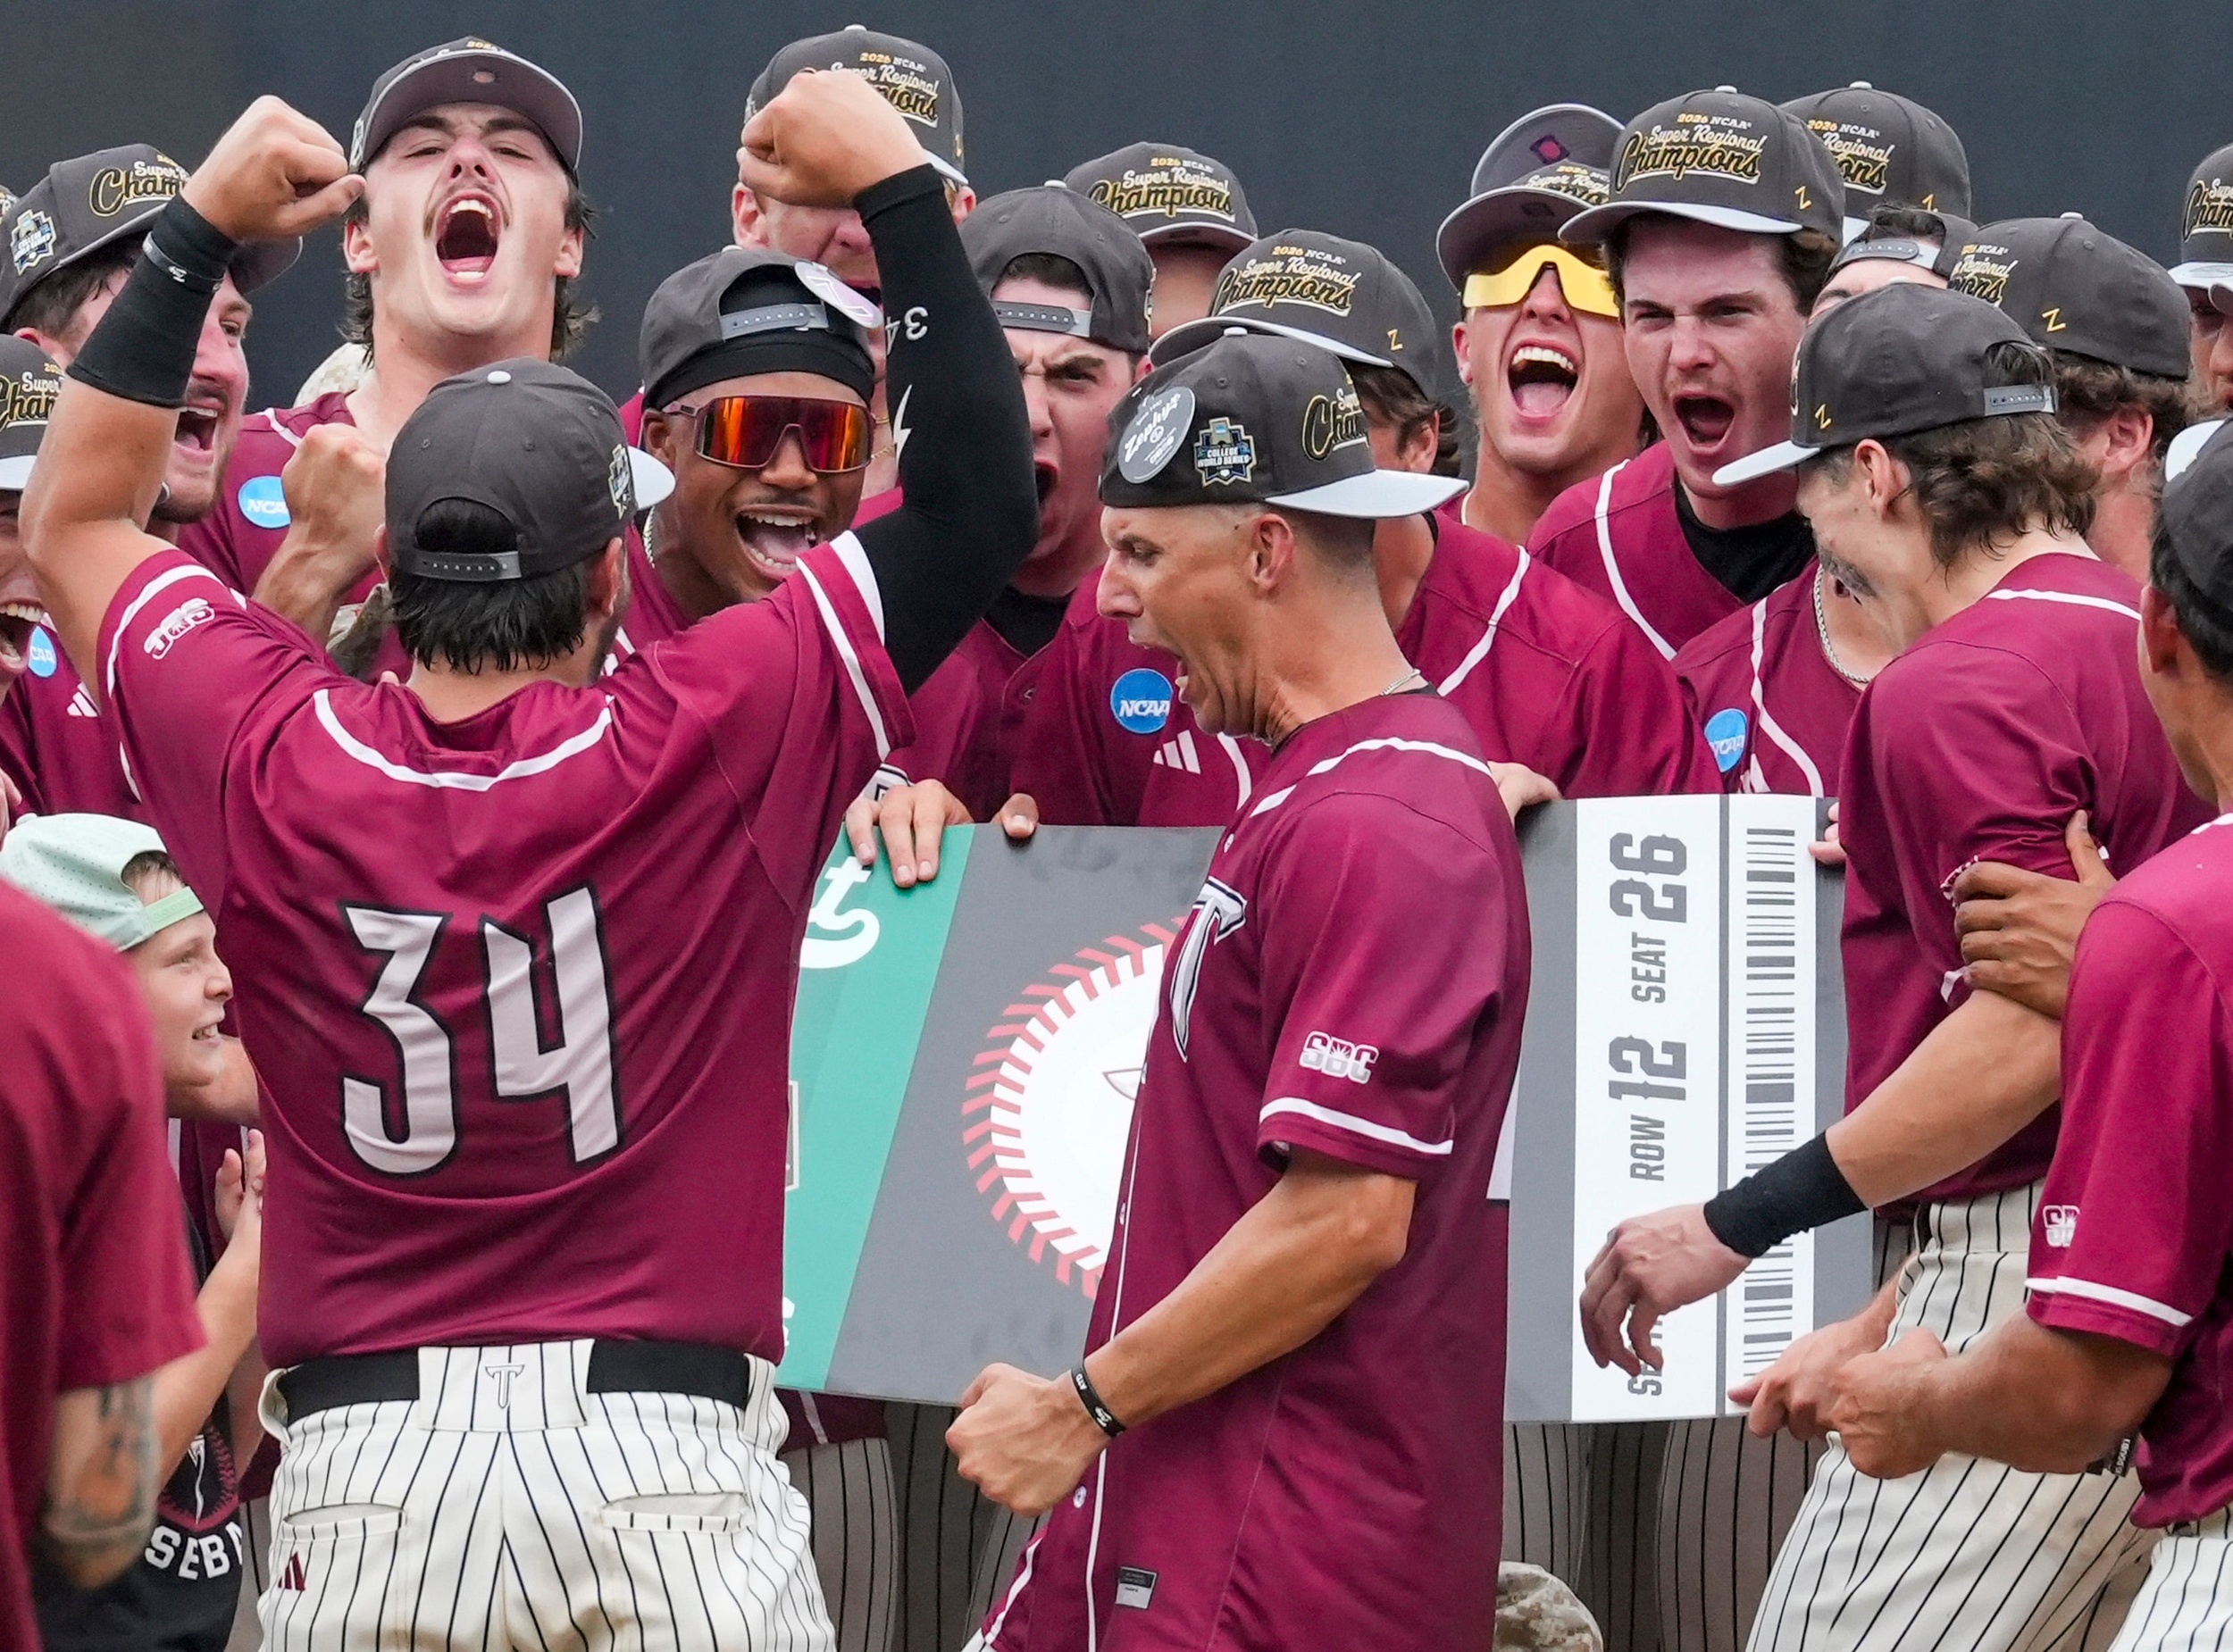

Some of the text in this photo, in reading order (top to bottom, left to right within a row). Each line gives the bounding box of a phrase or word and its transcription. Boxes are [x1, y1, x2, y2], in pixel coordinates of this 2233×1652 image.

[859, 53, 924, 72] 2026 NCAA
[880, 63, 940, 97] Regional
[1677, 113, 1752, 130] 2026 NCAA
[1807, 120, 1879, 139] 2026 NCAA
[1649, 125, 1768, 154] Super Regional
[1823, 131, 1895, 163] Regional
[1150, 158, 1181, 167] 2026
[1615, 131, 1761, 195] Champions
[1123, 167, 1230, 194] Super Regional
[1087, 179, 1235, 217] Champions
[1794, 186, 1812, 210] Z
[1272, 246, 1347, 265] 2026 NCAA
[1960, 254, 2019, 279] Regional
[1241, 257, 1362, 288] Super Regional
[1211, 267, 1353, 315] Champions
[2041, 307, 2067, 332] Z
[1387, 328, 1403, 352] Z
[1814, 404, 1832, 429] Z
[1207, 446, 1239, 458] COLLEGE
[1118, 699, 1171, 717] NCAA
[1608, 831, 1687, 1181] ROW 12 SEAT 26
[339, 882, 624, 1179] 34
[1299, 1030, 1380, 1084] SBC
